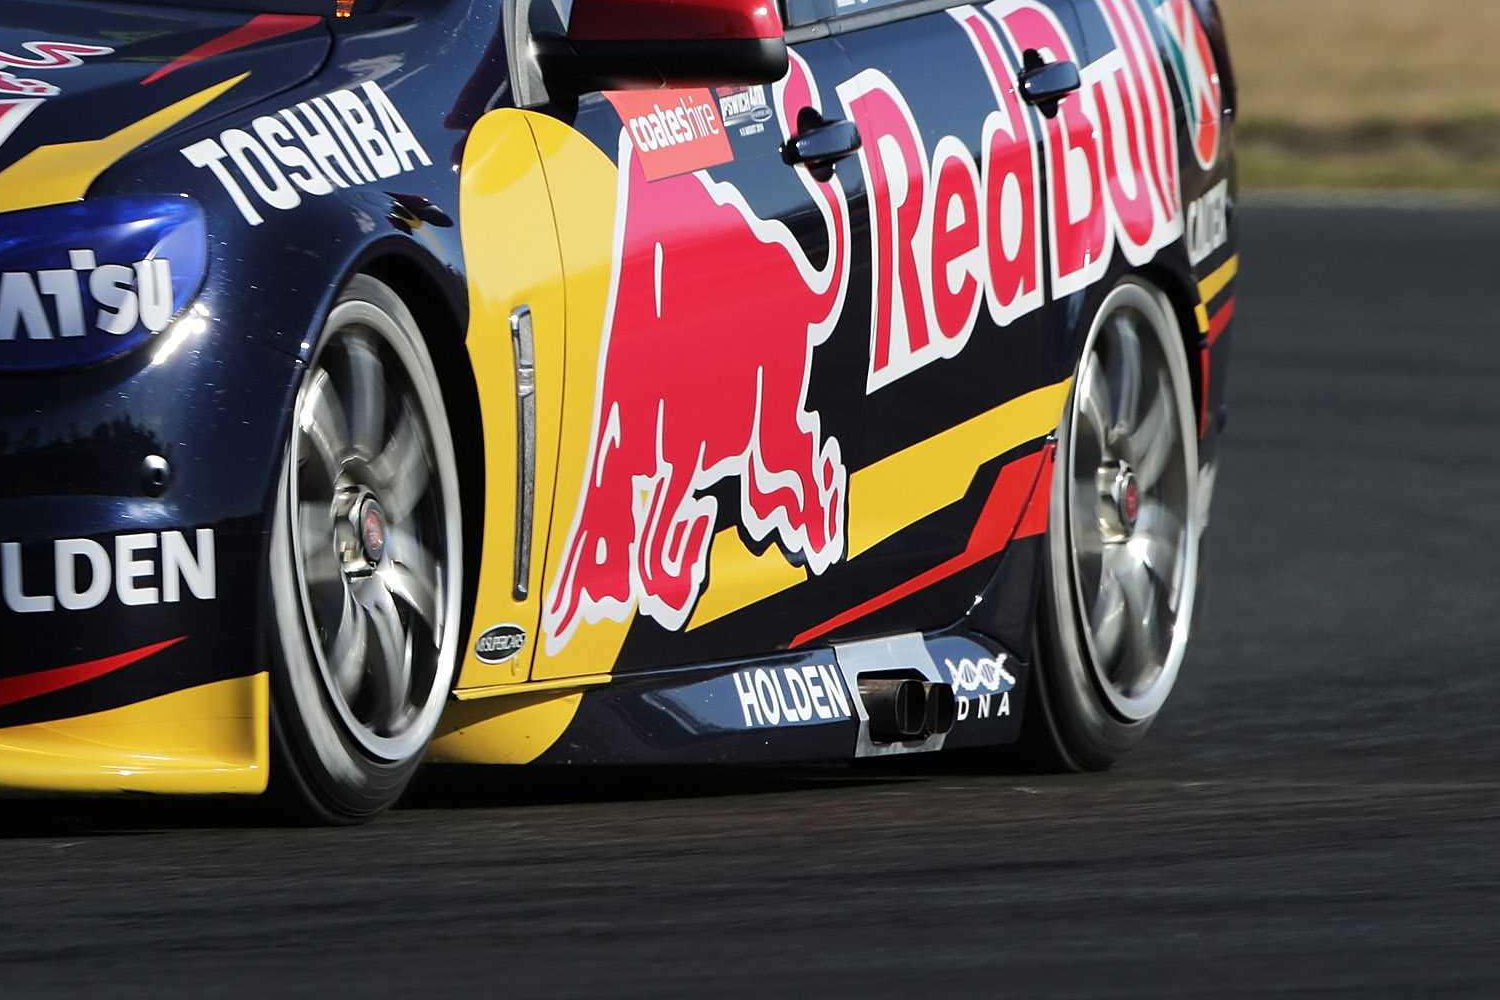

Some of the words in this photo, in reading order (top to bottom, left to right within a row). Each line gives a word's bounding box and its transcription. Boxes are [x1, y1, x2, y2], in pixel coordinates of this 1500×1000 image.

[180, 80, 434, 226] TOSHIBA
[732, 664, 852, 727] HOLDEN
[956, 692, 1011, 721] DNA
